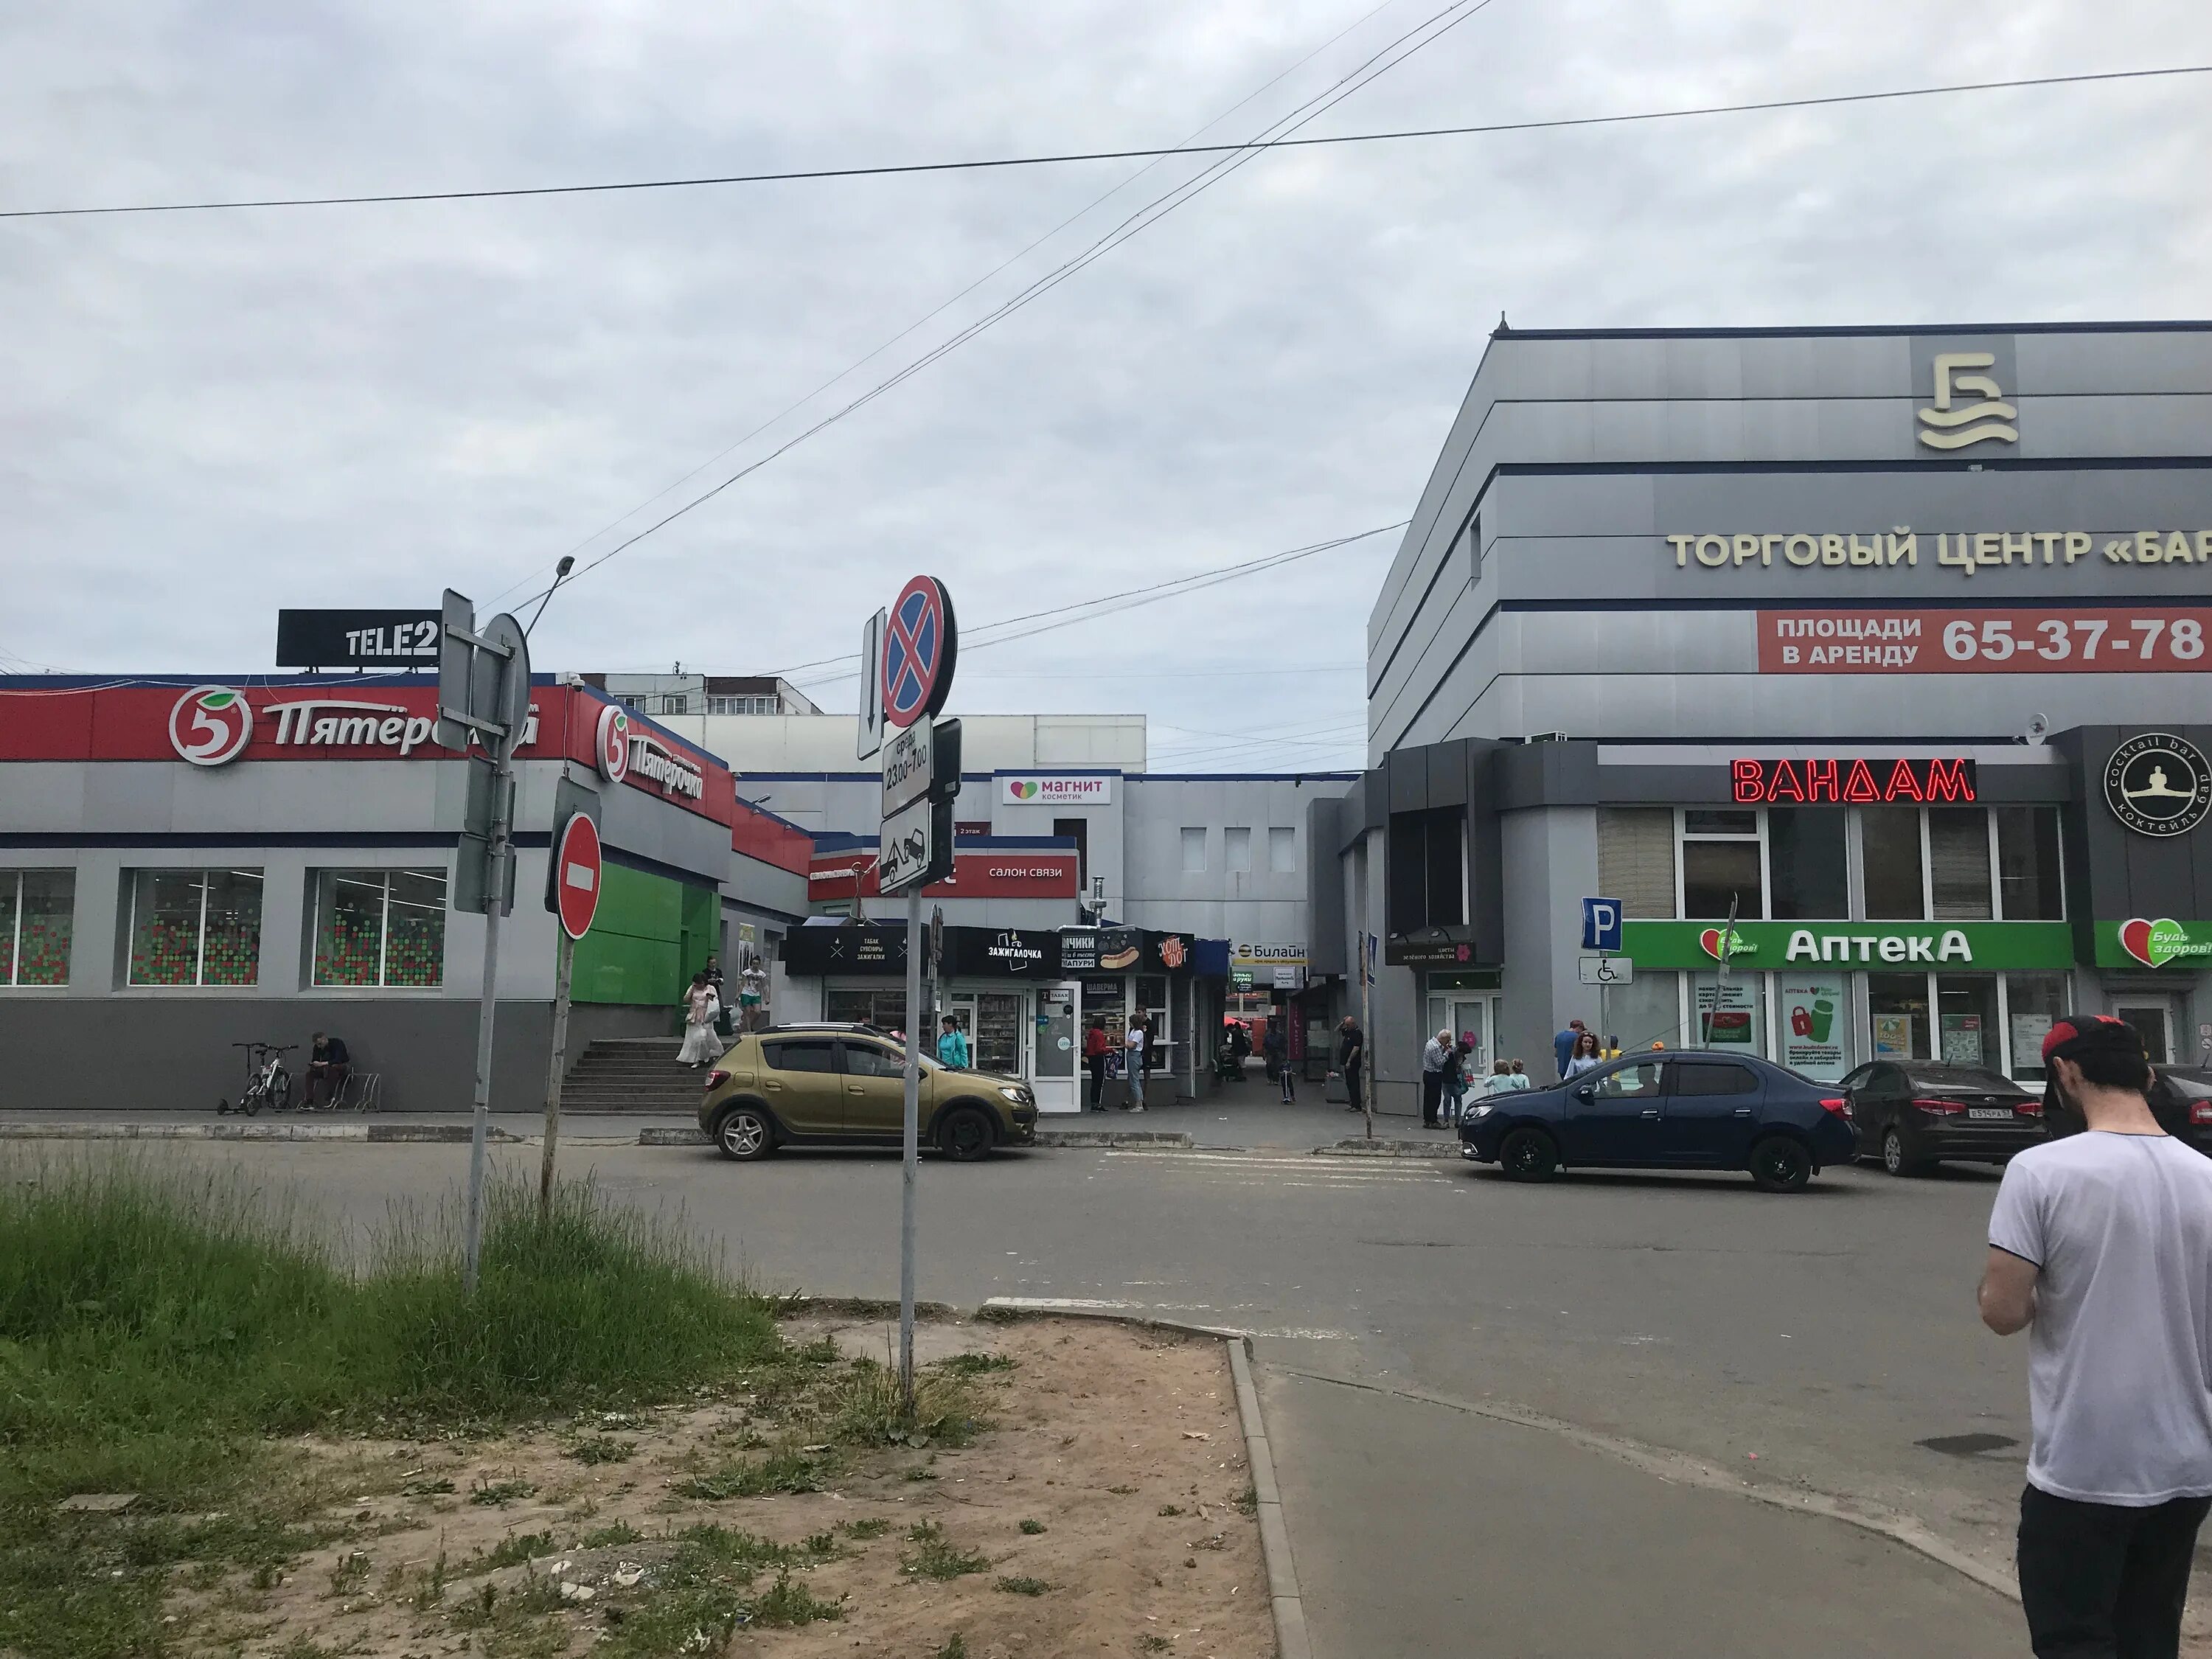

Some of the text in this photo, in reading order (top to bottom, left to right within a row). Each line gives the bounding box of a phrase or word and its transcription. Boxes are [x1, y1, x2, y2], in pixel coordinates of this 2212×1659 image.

[1666, 525, 1917, 566] ТОРГОВЫЙ
[1936, 532, 2093, 576] ЦЕНТР
[346, 620, 439, 656] TELE2
[1777, 619, 1921, 640] ПЛОЩАДИ
[1943, 619, 2205, 661] 65-37-78
[1783, 646, 1919, 667] В АРЕНДУ
[897, 731, 916, 757] среда
[2110, 737, 2197, 787] cocktail bar
[1733, 759, 1975, 801] ВАНДАМ
[2118, 804, 2197, 832] коктейль
[989, 869, 1062, 877] салон связи
[2153, 932, 2188, 942] Будь
[2154, 943, 2212, 954] здоров!
[988, 947, 1042, 959] ЗАЖИГАЛОЧКА
[1254, 945, 1305, 957] Билайн
